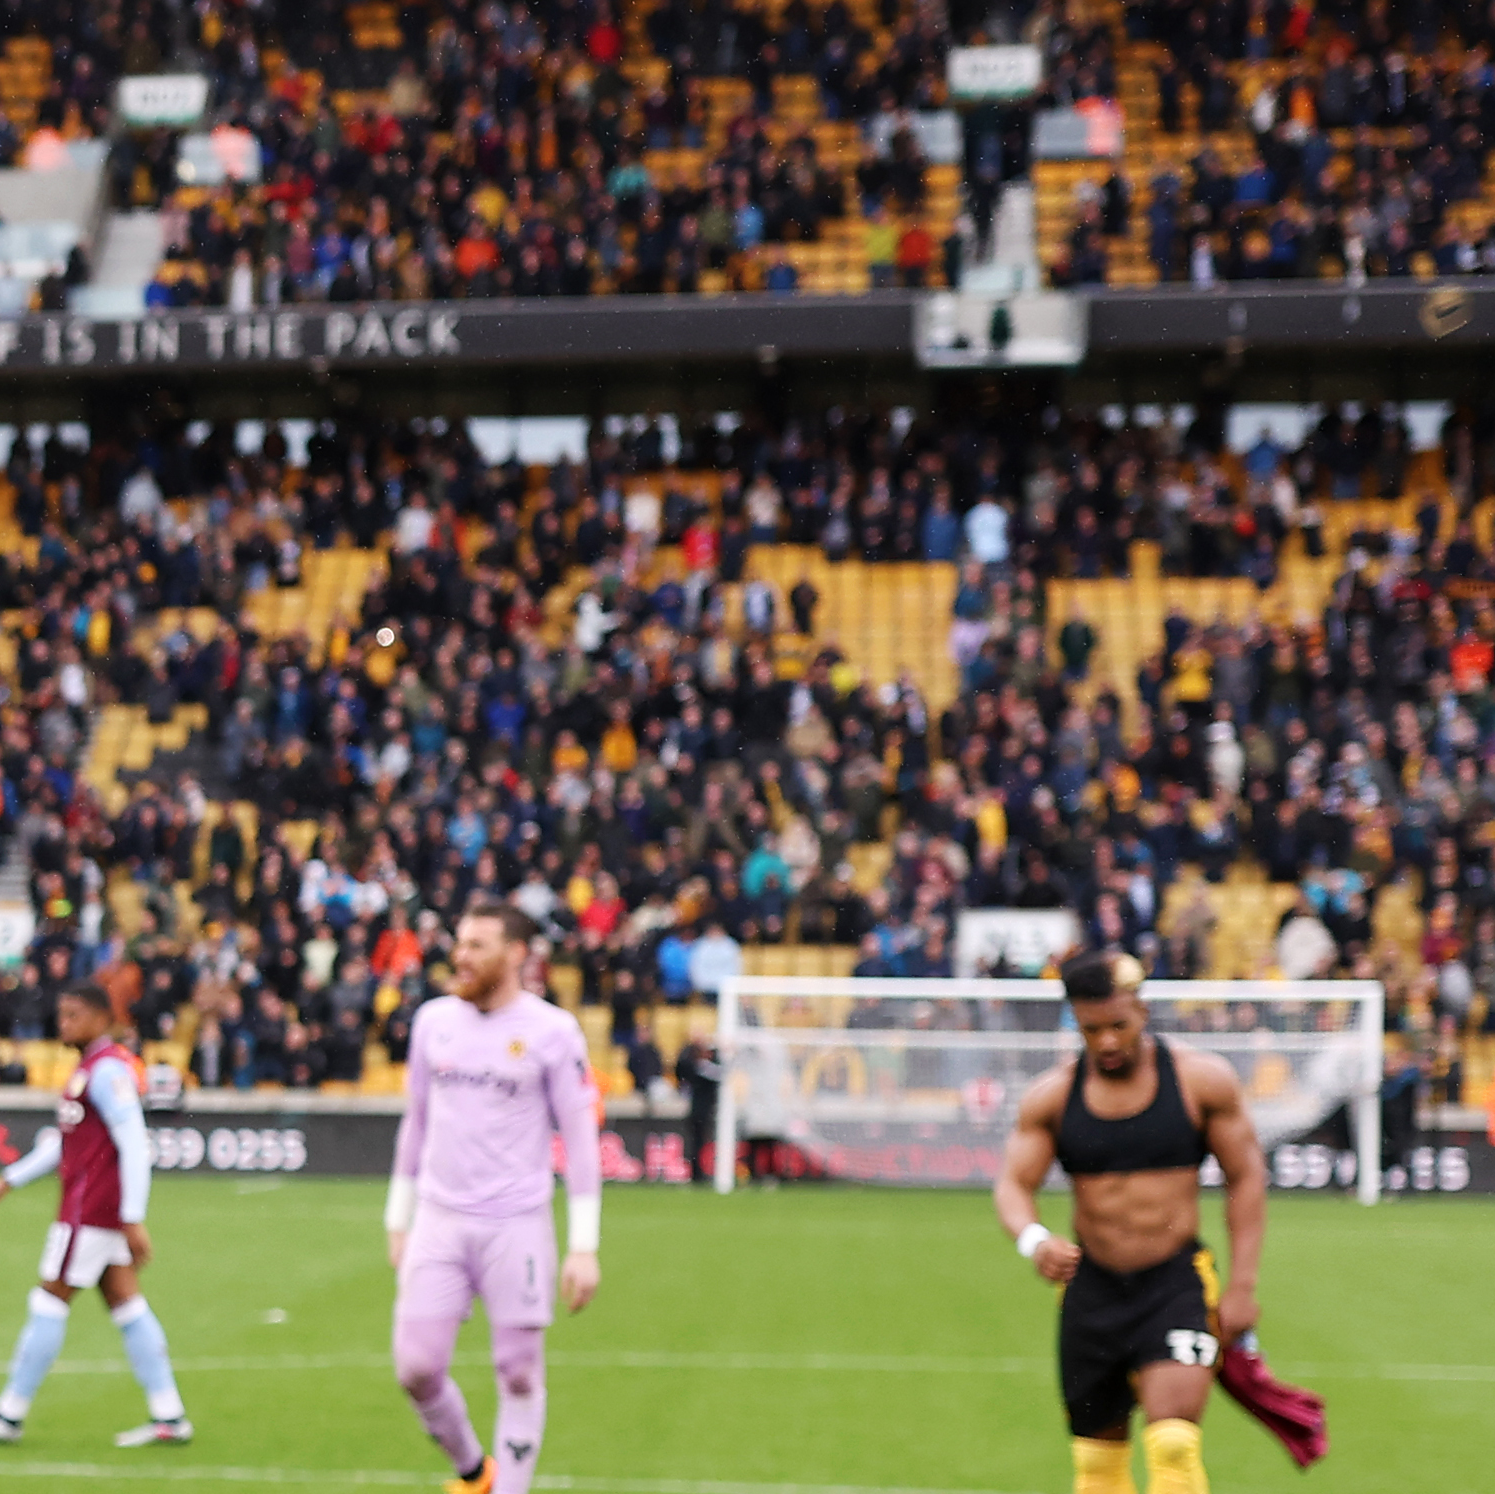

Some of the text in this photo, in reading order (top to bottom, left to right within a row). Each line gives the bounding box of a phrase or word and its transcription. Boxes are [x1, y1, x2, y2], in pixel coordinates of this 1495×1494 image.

[44, 316, 96, 367] IS
[117, 315, 180, 364] IN
[205, 312, 305, 360] THE
[324, 309, 462, 358] PACK
